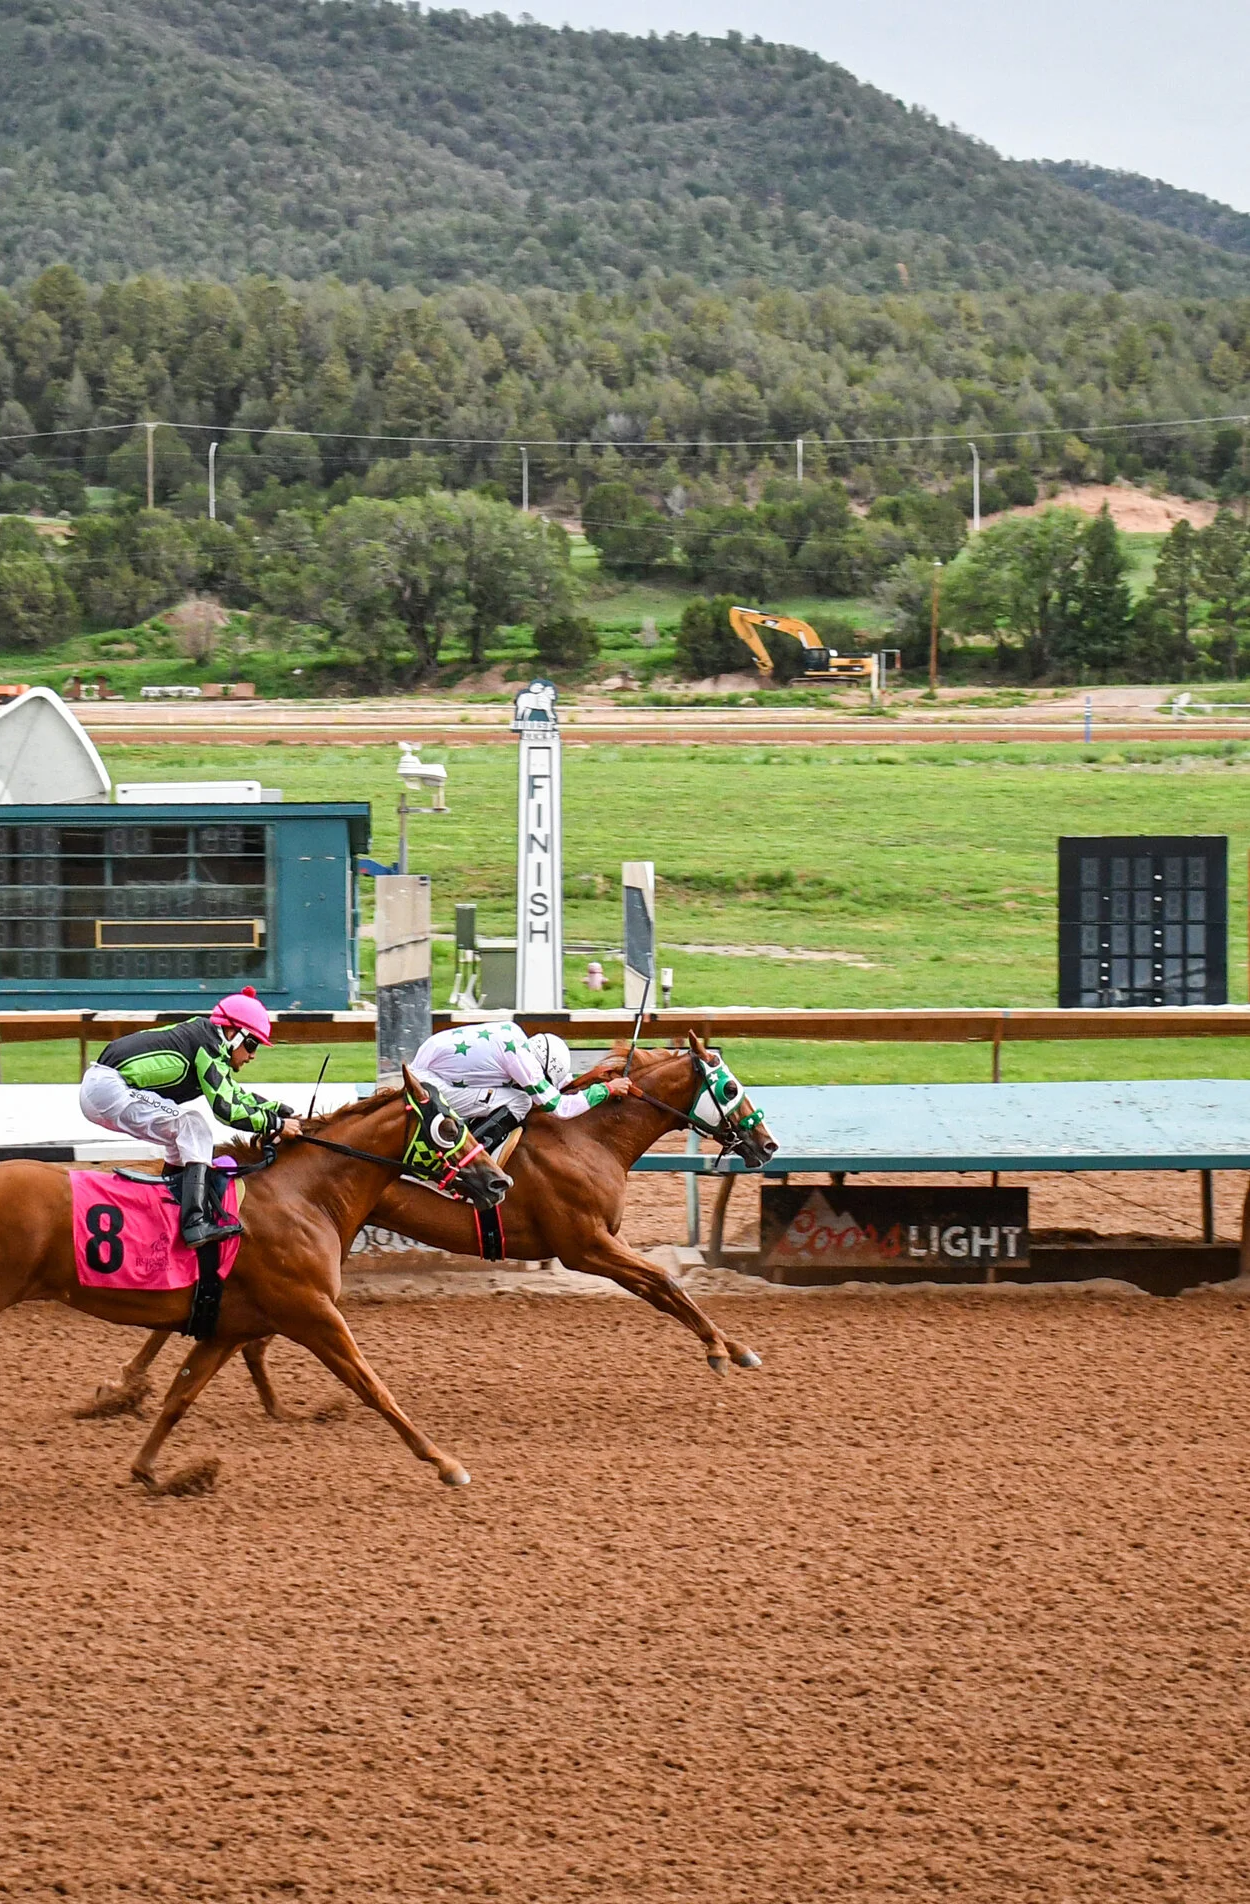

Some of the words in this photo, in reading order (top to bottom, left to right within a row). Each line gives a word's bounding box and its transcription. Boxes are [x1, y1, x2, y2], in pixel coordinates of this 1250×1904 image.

[527, 774, 550, 944] FINISH
[85, 1203, 124, 1274] 8
[776, 1209, 900, 1258] Coors
[908, 1224, 1023, 1258] LIGHT
